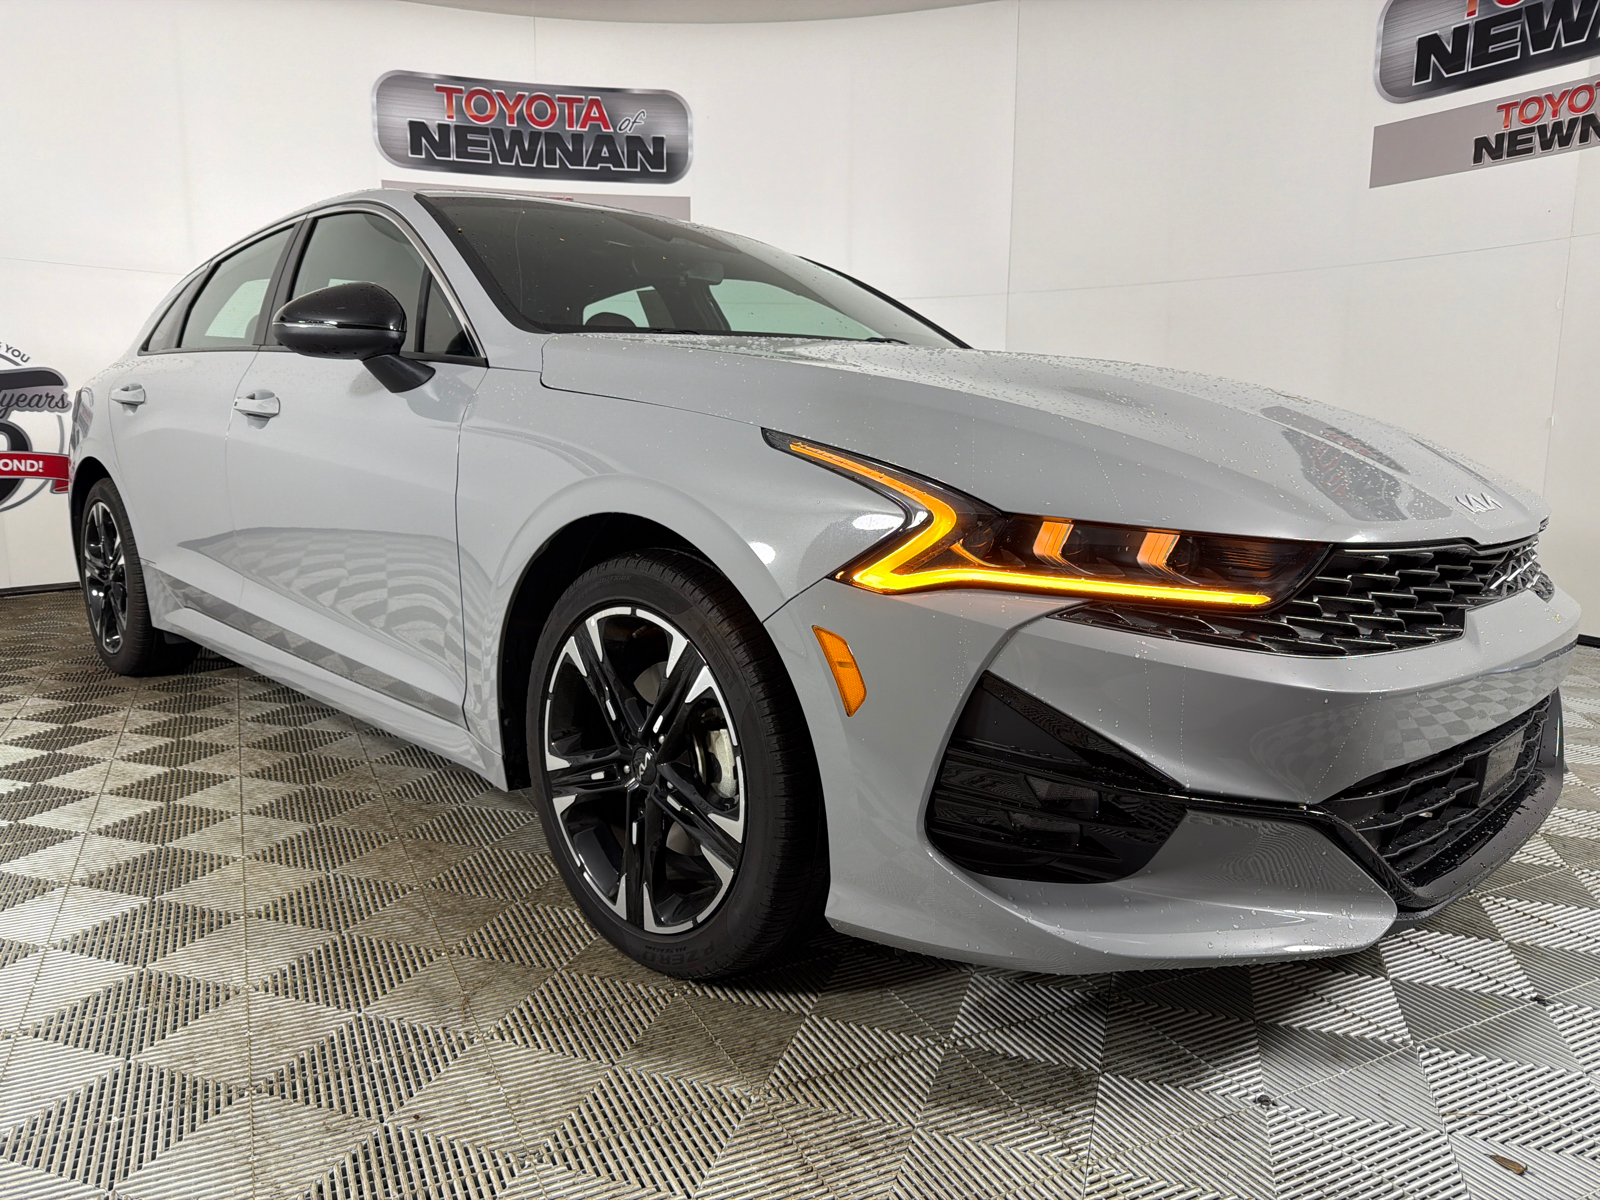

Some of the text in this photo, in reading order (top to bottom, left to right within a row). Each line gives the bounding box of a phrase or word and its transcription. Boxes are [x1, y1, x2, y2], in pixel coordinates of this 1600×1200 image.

[1412, 0, 1600, 86] NEW
[433, 83, 646, 134] TOYOTA of
[1497, 81, 1600, 130] TOYO
[407, 119, 667, 172] NEWNAN
[5, 343, 31, 363] YOU
[0, 392, 69, 419] years
[642, 949, 699, 965] ZERO
